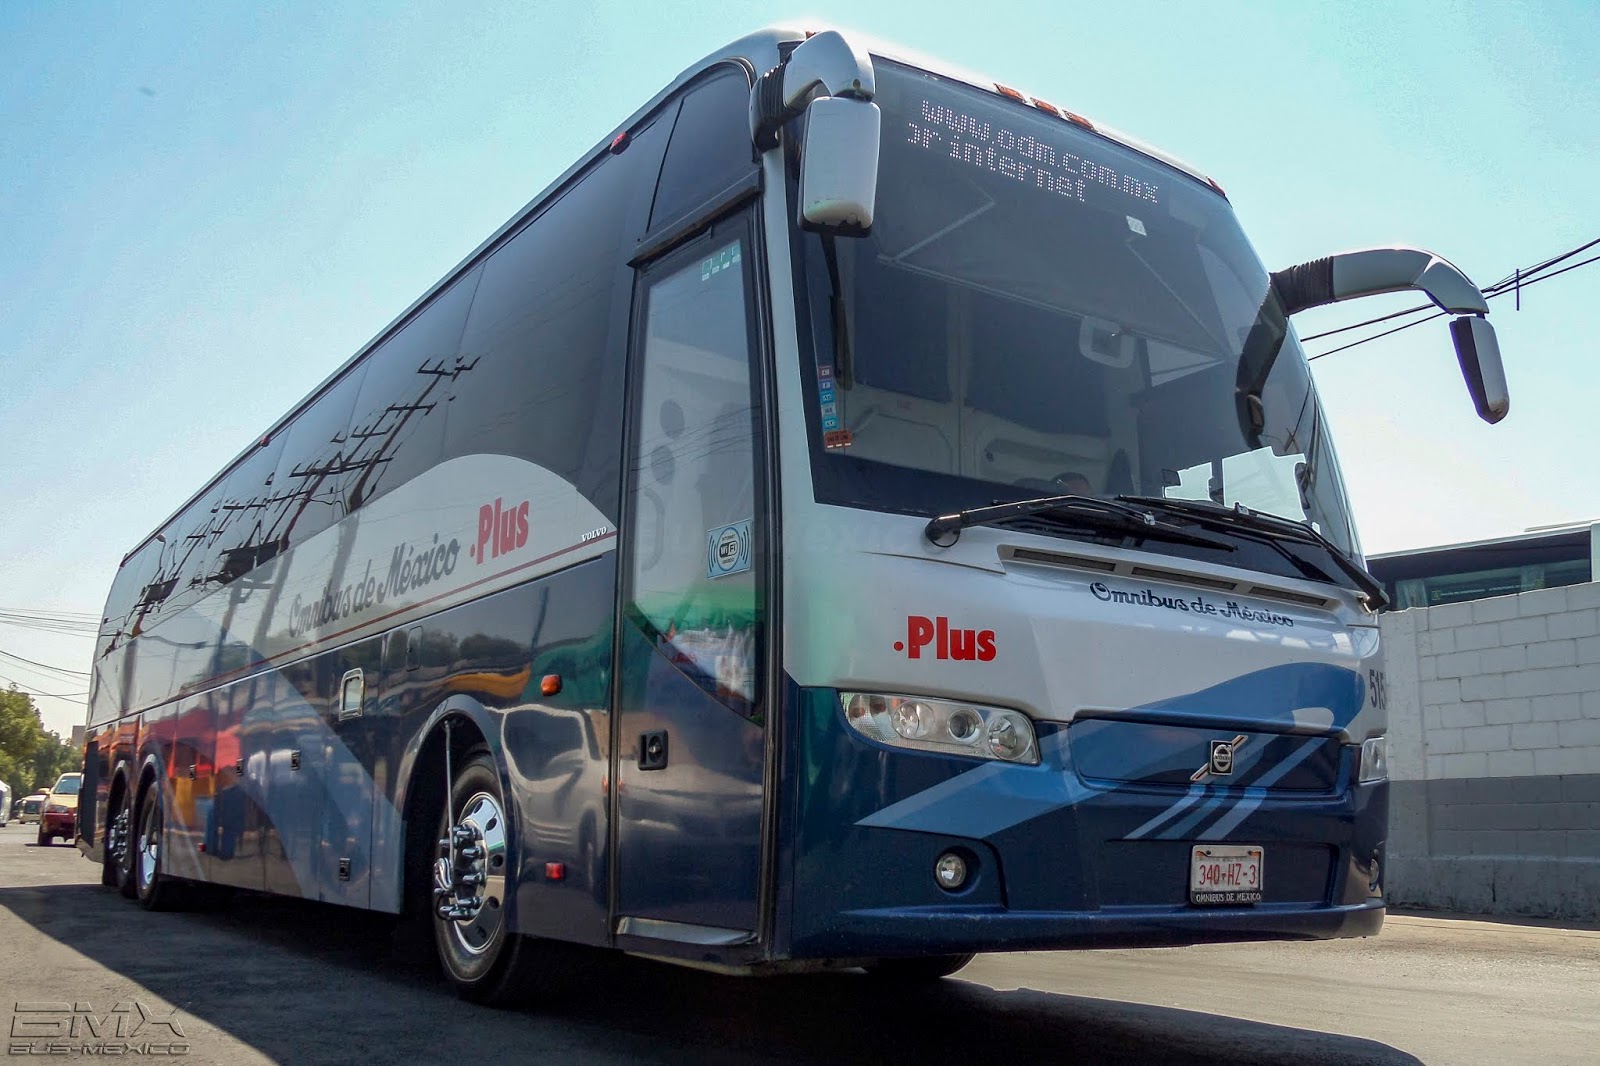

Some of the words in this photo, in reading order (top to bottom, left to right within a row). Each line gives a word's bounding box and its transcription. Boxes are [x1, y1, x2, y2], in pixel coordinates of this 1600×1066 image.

[922, 100, 1158, 203] www.odm.com.mx
[949, 135, 1086, 202] internet
[582, 526, 607, 542] VOLVO
[289, 577, 353, 637] Omnibus
[353, 559, 375, 613] de
[377, 533, 461, 604] México
[1089, 582, 1189, 612] Omnibus
[1190, 597, 1217, 615] de
[1220, 601, 1294, 628] México
[1196, 893, 1225, 902] OMNIBUS
[1226, 893, 1235, 902] DE
[1236, 892, 1261, 902] MEXICO
